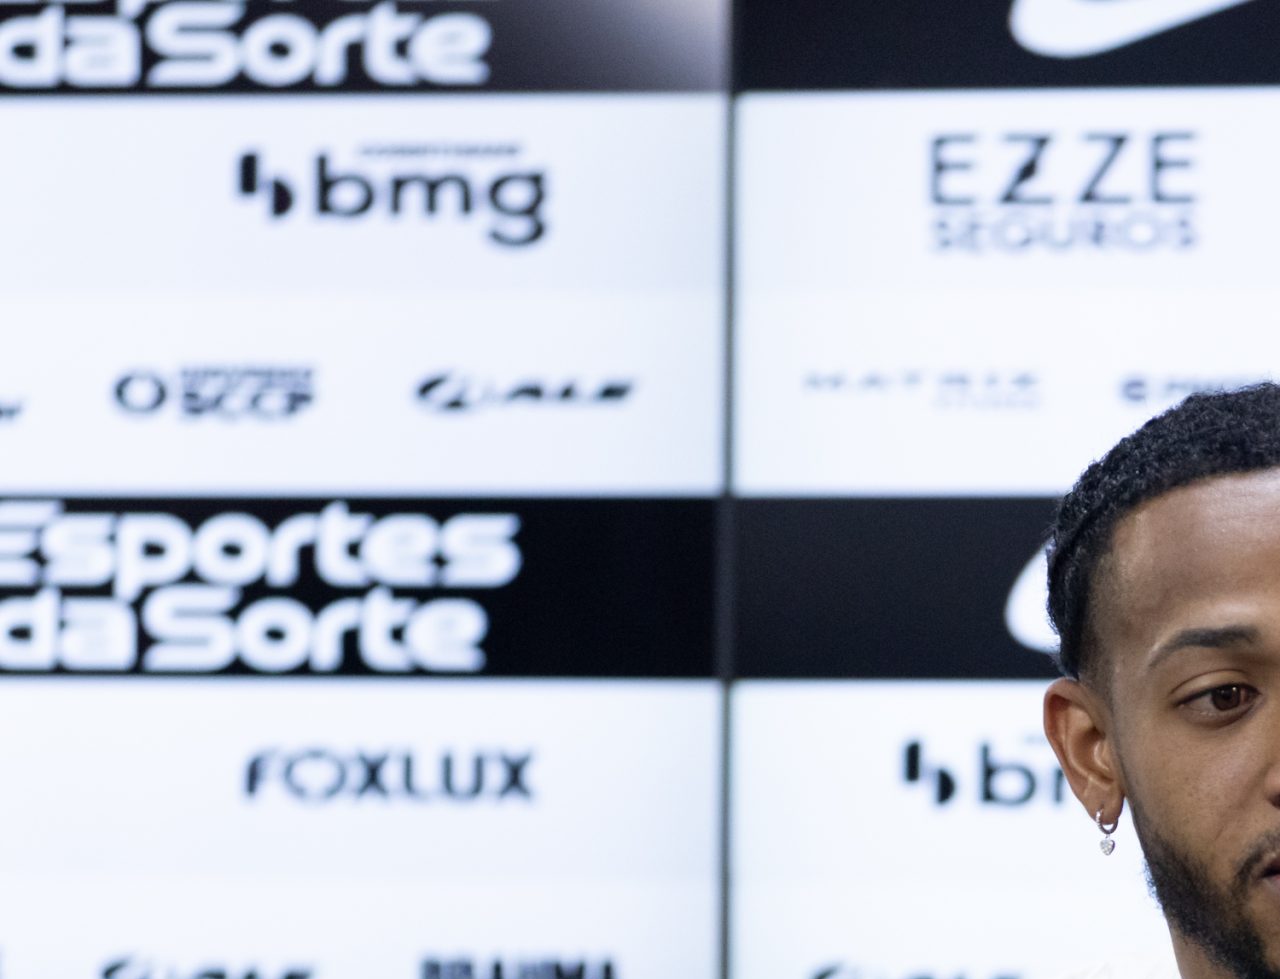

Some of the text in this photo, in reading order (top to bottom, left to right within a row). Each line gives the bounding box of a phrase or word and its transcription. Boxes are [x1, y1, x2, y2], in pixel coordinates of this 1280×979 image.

[144, 0, 492, 87] Sorte
[317, 153, 547, 247] bmg
[930, 132, 1198, 204] EZZE
[932, 211, 1200, 253] SEGUROS
[0, 498, 522, 603] Esportes
[142, 583, 488, 672] Sorte
[244, 750, 534, 802] FOXLUX
